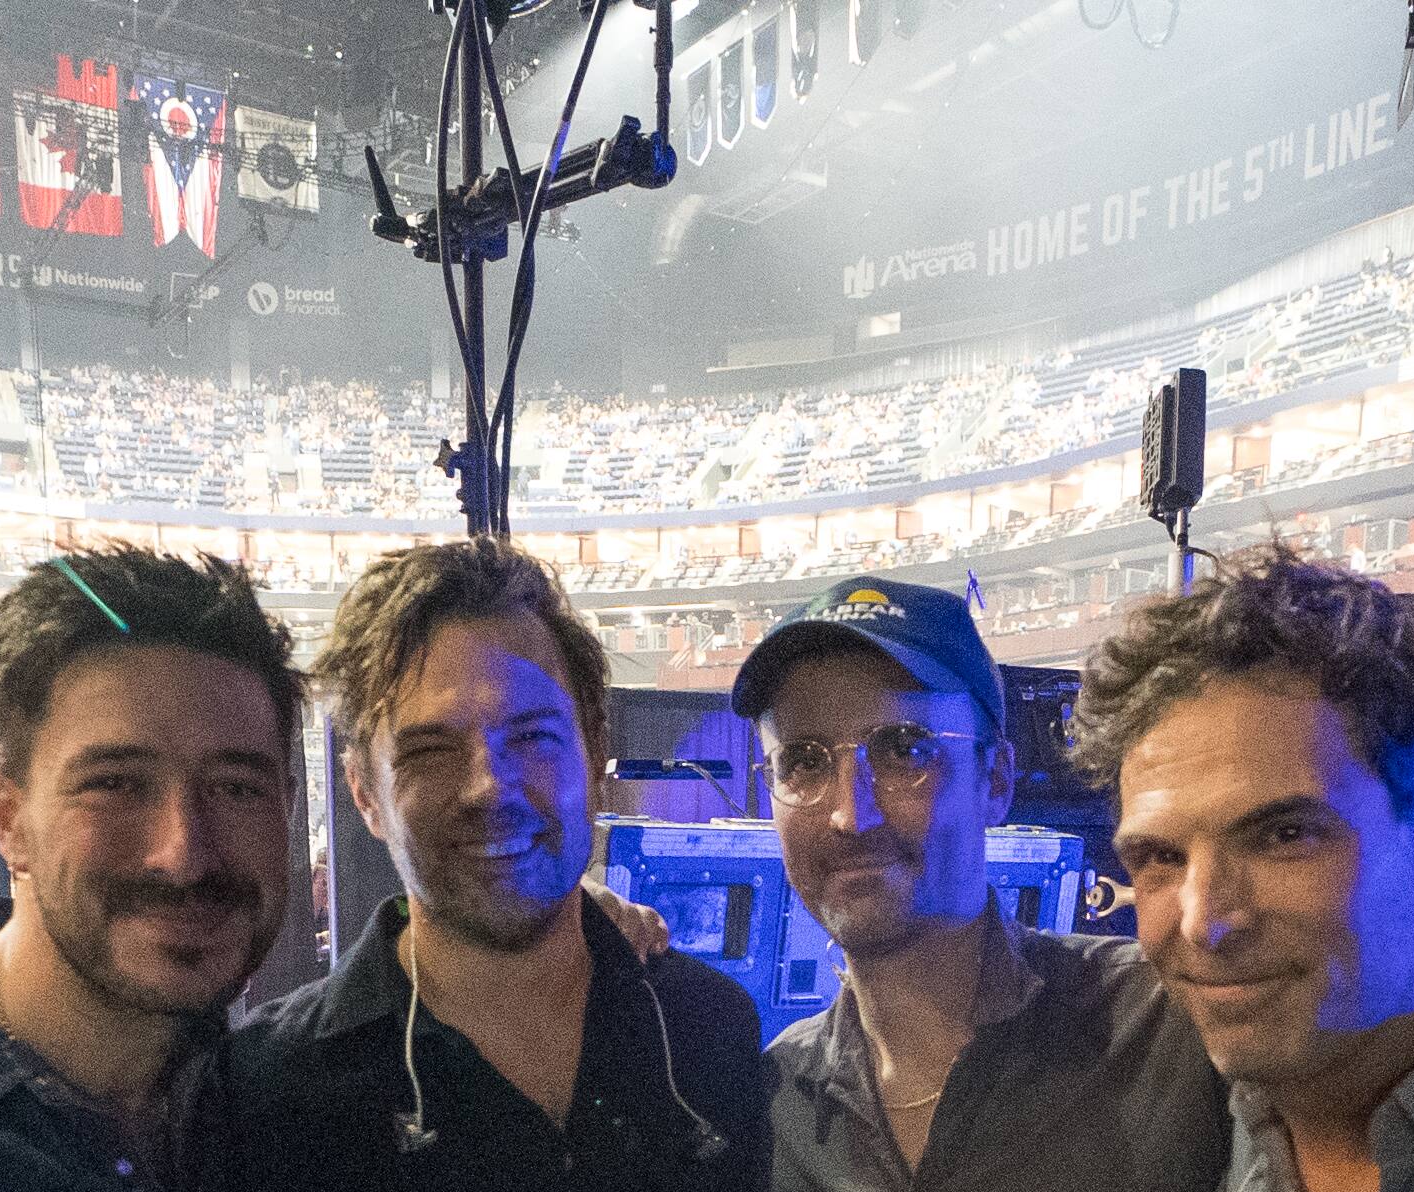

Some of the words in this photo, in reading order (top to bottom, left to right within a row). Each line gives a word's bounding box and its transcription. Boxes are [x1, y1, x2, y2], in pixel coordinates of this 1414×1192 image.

[987, 201, 1091, 277] HOME
[1102, 186, 1151, 246] OF
[1164, 158, 1232, 230] THE
[1243, 131, 1294, 203] 5TH
[905, 239, 975, 261] Nationwide
[55, 267, 144, 292] Nationwide
[880, 250, 976, 286] Arena
[285, 285, 335, 302] bread
[285, 303, 338, 316] financial
